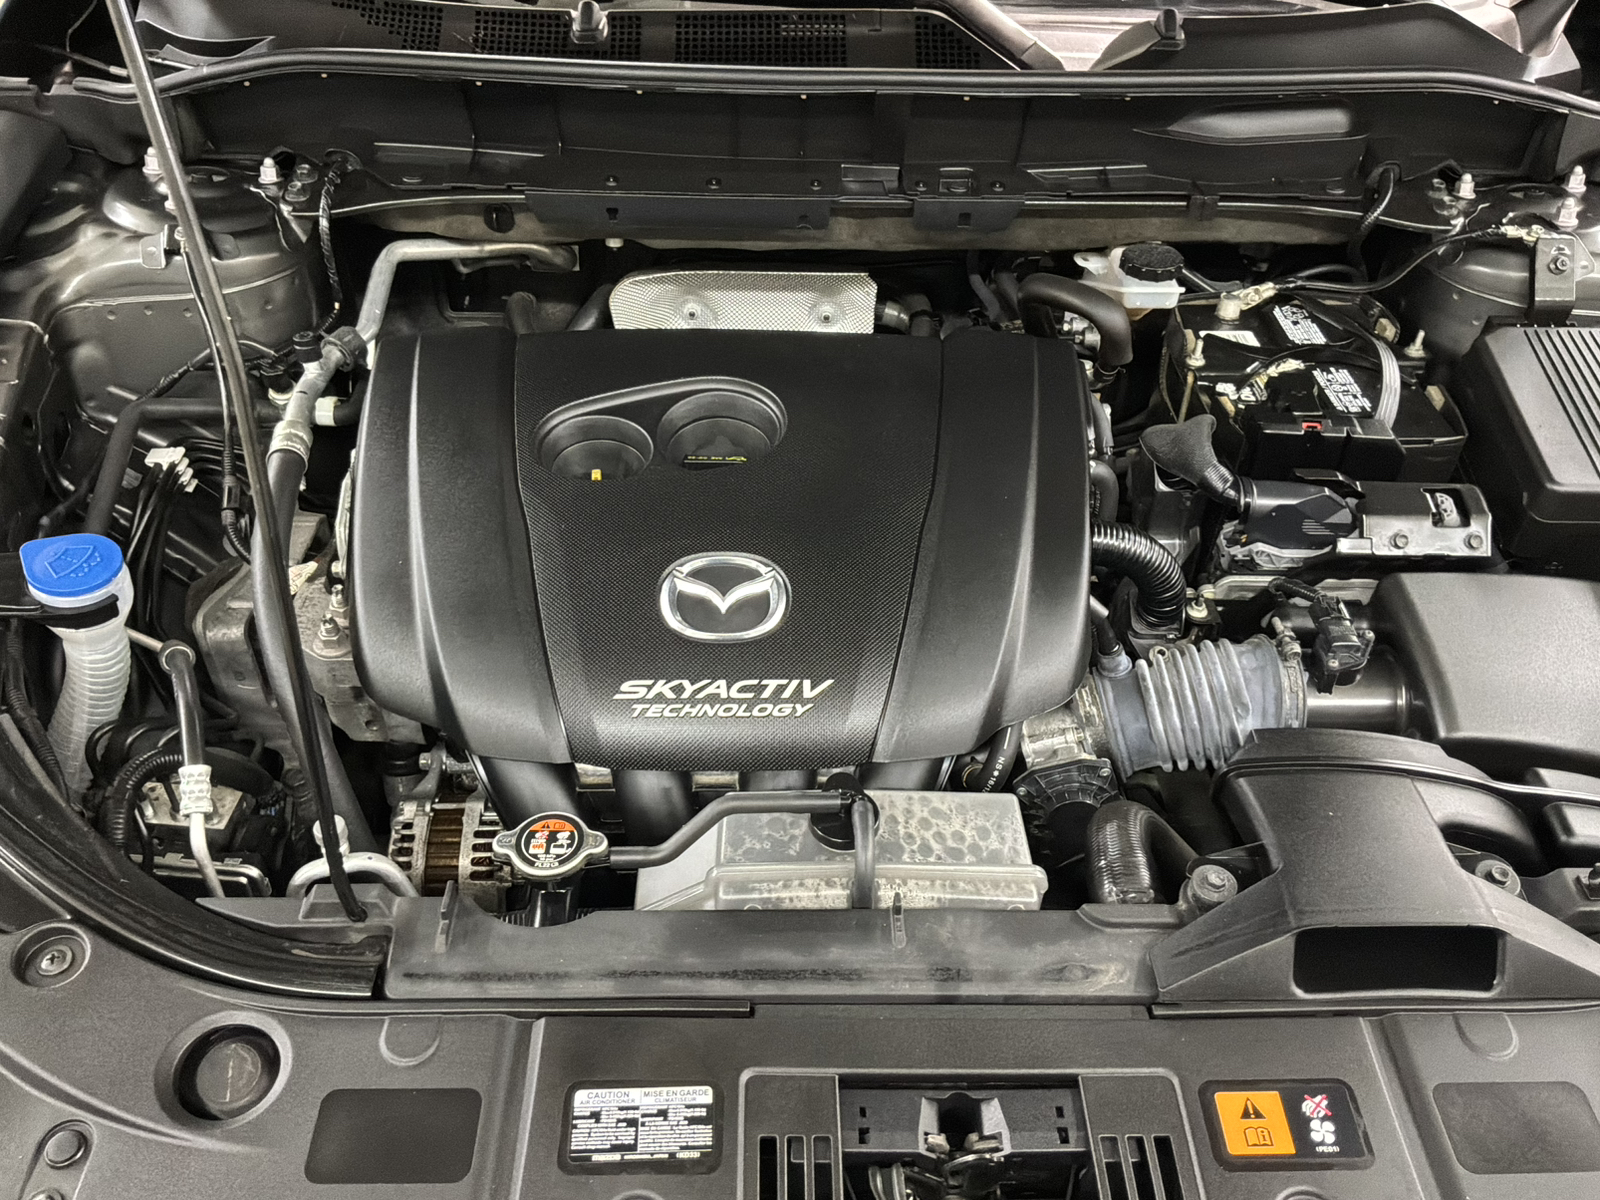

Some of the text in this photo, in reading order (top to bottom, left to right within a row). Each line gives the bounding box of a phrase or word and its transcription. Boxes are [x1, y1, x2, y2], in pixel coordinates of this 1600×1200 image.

[613, 679, 835, 699] SKYACTIV
[631, 703, 814, 718] TECHNOLOGY
[587, 1091, 630, 1100] CAUTION
[643, 1089, 710, 1098] MISE EN GARDE
